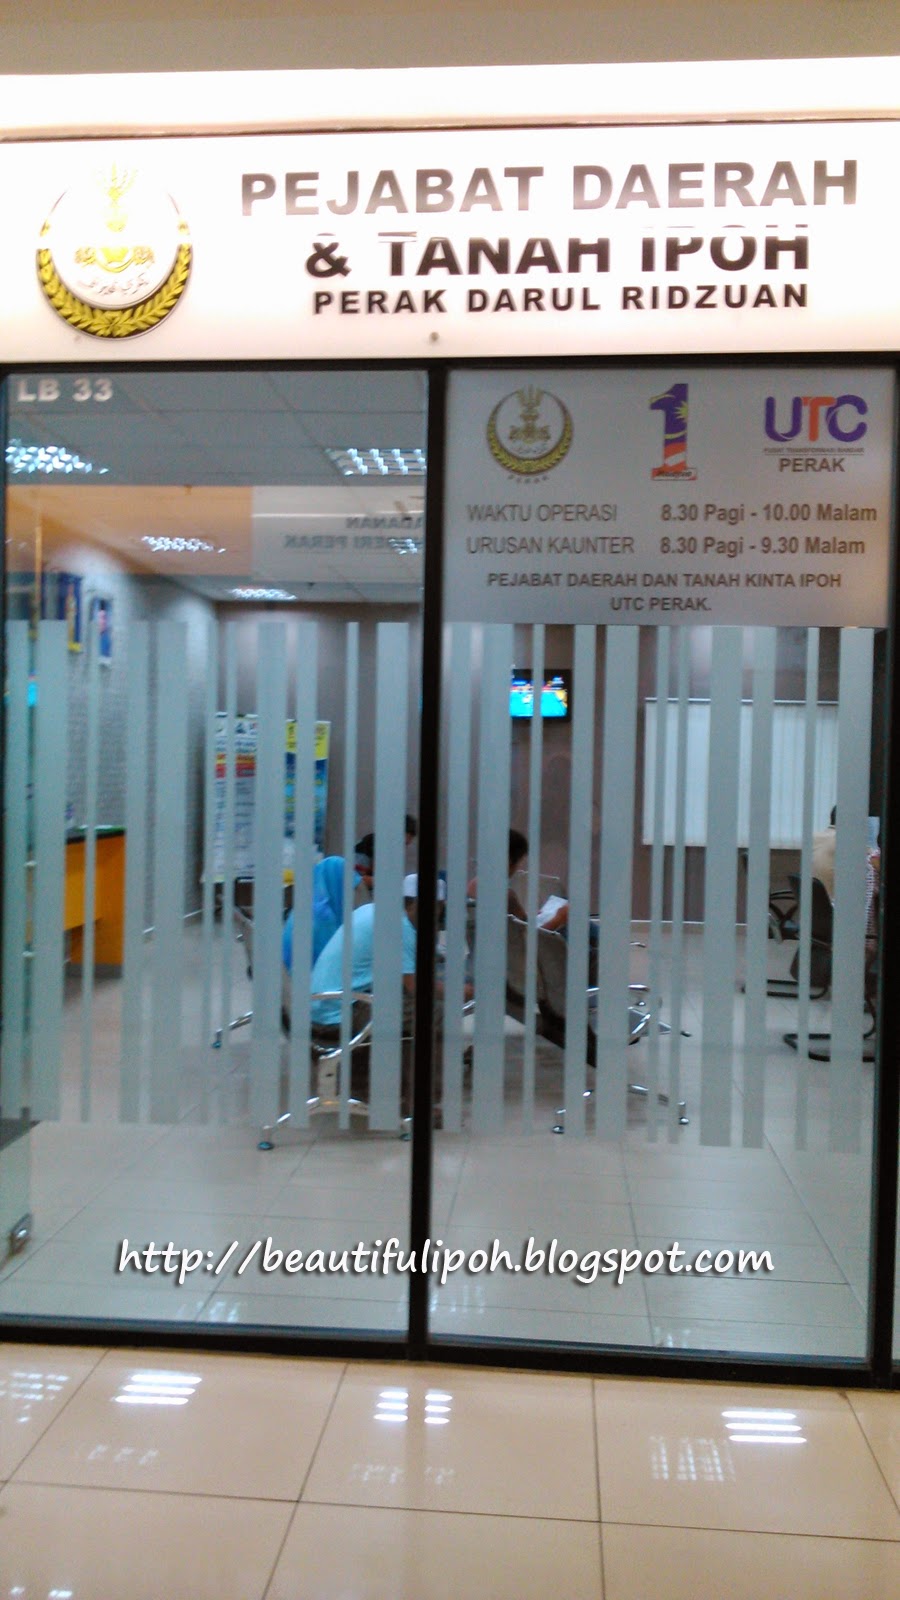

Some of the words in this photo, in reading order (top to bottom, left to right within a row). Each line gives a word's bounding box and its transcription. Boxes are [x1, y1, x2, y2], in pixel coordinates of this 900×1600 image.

[241, 166, 544, 216] PEJABAT
[573, 160, 857, 210] DAERAH
[305, 232, 352, 278] &
[377, 231, 611, 276] TANAH
[640, 224, 809, 272] IPOH
[313, 290, 448, 315] PERAK
[467, 286, 601, 312] DARUL
[621, 283, 808, 310] RIDZUAN
[17, 378, 61, 402] LB
[72, 378, 114, 402] 33
[764, 394, 868, 443] UTC
[779, 458, 846, 473] PERAK
[467, 504, 531, 521] WAKTU
[536, 504, 618, 521] OPERASI
[660, 504, 699, 521] 8.30
[703, 503, 745, 525] Pagi
[763, 503, 811, 521] 10.00
[816, 503, 877, 521] Malam
[466, 536, 543, 554] URUSAN
[549, 536, 635, 554] KAUNTER
[660, 536, 698, 554] 8.30
[703, 536, 744, 558] Pagi
[761, 536, 799, 554] 9.30
[805, 536, 866, 554] Malam
[487, 573, 562, 587] PEJABAT
[567, 573, 637, 587] DAERAH
[642, 573, 678, 587] DAN
[683, 573, 740, 588] TANAH
[745, 573, 796, 588] KINTA
[800, 573, 842, 588] IPOH
[611, 597, 644, 611] UTC
[649, 597, 712, 612] PERAK.
